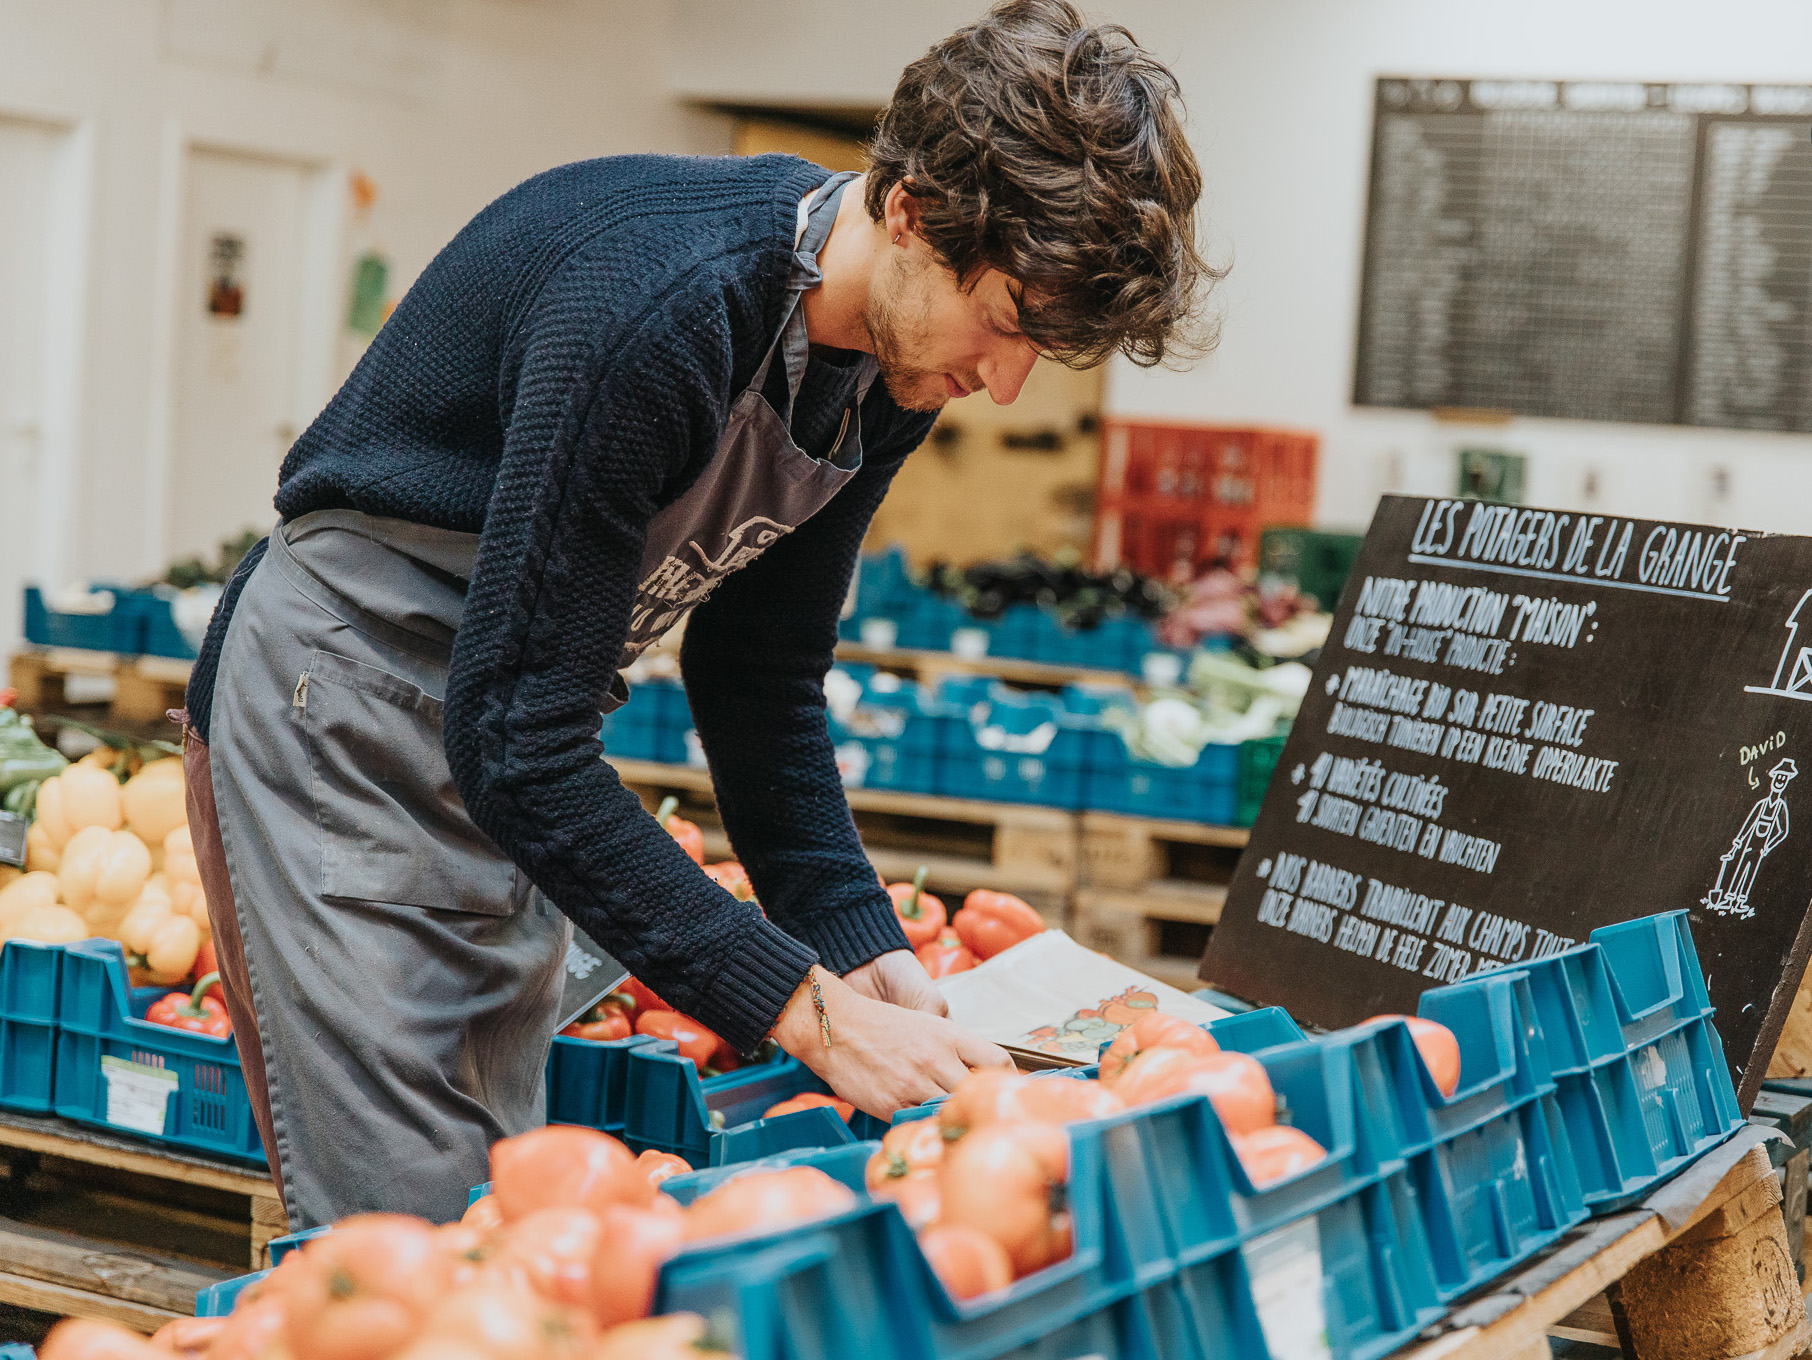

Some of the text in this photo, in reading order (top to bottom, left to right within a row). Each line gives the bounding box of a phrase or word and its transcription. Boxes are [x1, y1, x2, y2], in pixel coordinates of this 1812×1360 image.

[1411, 499, 1747, 595] LES POTAGERS DE LA GRANGE
[1354, 576, 1417, 622] NOTRE
[1343, 614, 1386, 653] ONZE
[1447, 688, 1479, 728] SUR
[1477, 693, 1530, 736] PETITE
[1524, 700, 1595, 748] SURFACE
[1440, 726, 1462, 760] OP
[1455, 729, 1487, 764] EEN
[1482, 735, 1534, 775] KLEINE
[1532, 745, 1619, 793] OPPERVLAKTE
[1417, 823, 1443, 860] EN
[1267, 851, 1308, 894] NOS
[1436, 903, 1473, 945] AUX
[1468, 911, 1531, 962] CHAMPS
[1374, 927, 1399, 964] DE
[1391, 933, 1428, 972] HELE
[1422, 941, 1472, 985] ZOMER
